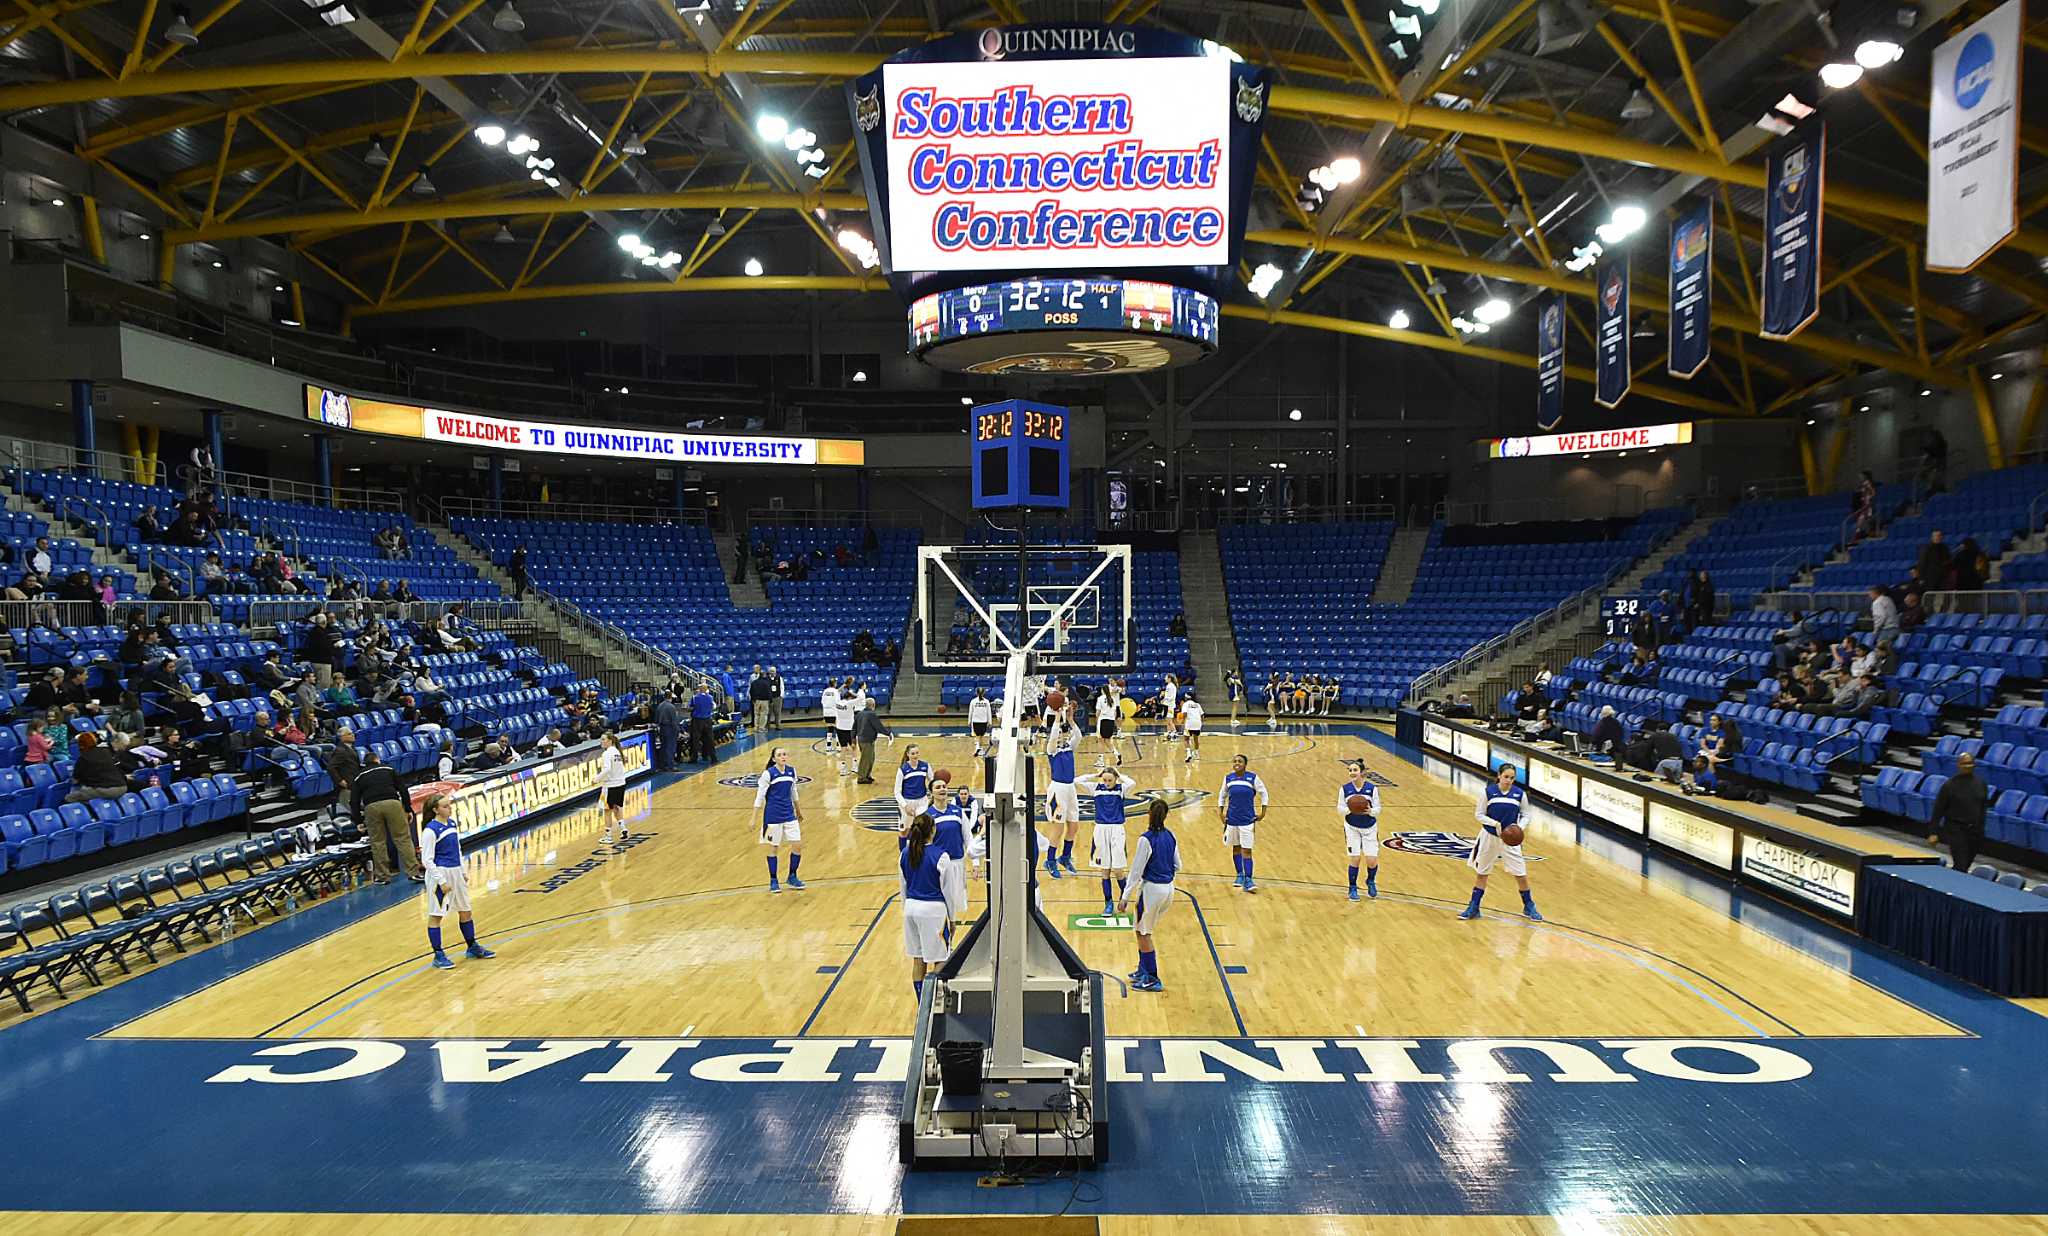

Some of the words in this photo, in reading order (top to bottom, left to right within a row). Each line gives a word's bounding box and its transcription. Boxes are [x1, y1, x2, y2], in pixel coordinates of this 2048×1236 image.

[978, 27, 1136, 60] QUINNIPIAC
[894, 85, 1133, 139] Southern
[910, 139, 1221, 195] Connecticut
[934, 199, 1224, 251] Conference
[969, 295, 981, 312] 0
[1008, 280, 1086, 311] 32:12
[1091, 284, 1118, 294] HALF
[1100, 296, 1108, 309] 1
[1044, 313, 1078, 324] POSS
[437, 416, 521, 444] WELCOME
[530, 429, 556, 446] TO
[564, 432, 674, 456] QUINNIPIAC
[683, 439, 803, 459] UNIVERSITY
[978, 411, 1013, 440] 32:12
[1557, 429, 1649, 451] WELCOME
[1754, 841, 1806, 876] CHARTER
[1810, 860, 1840, 889] OAK
